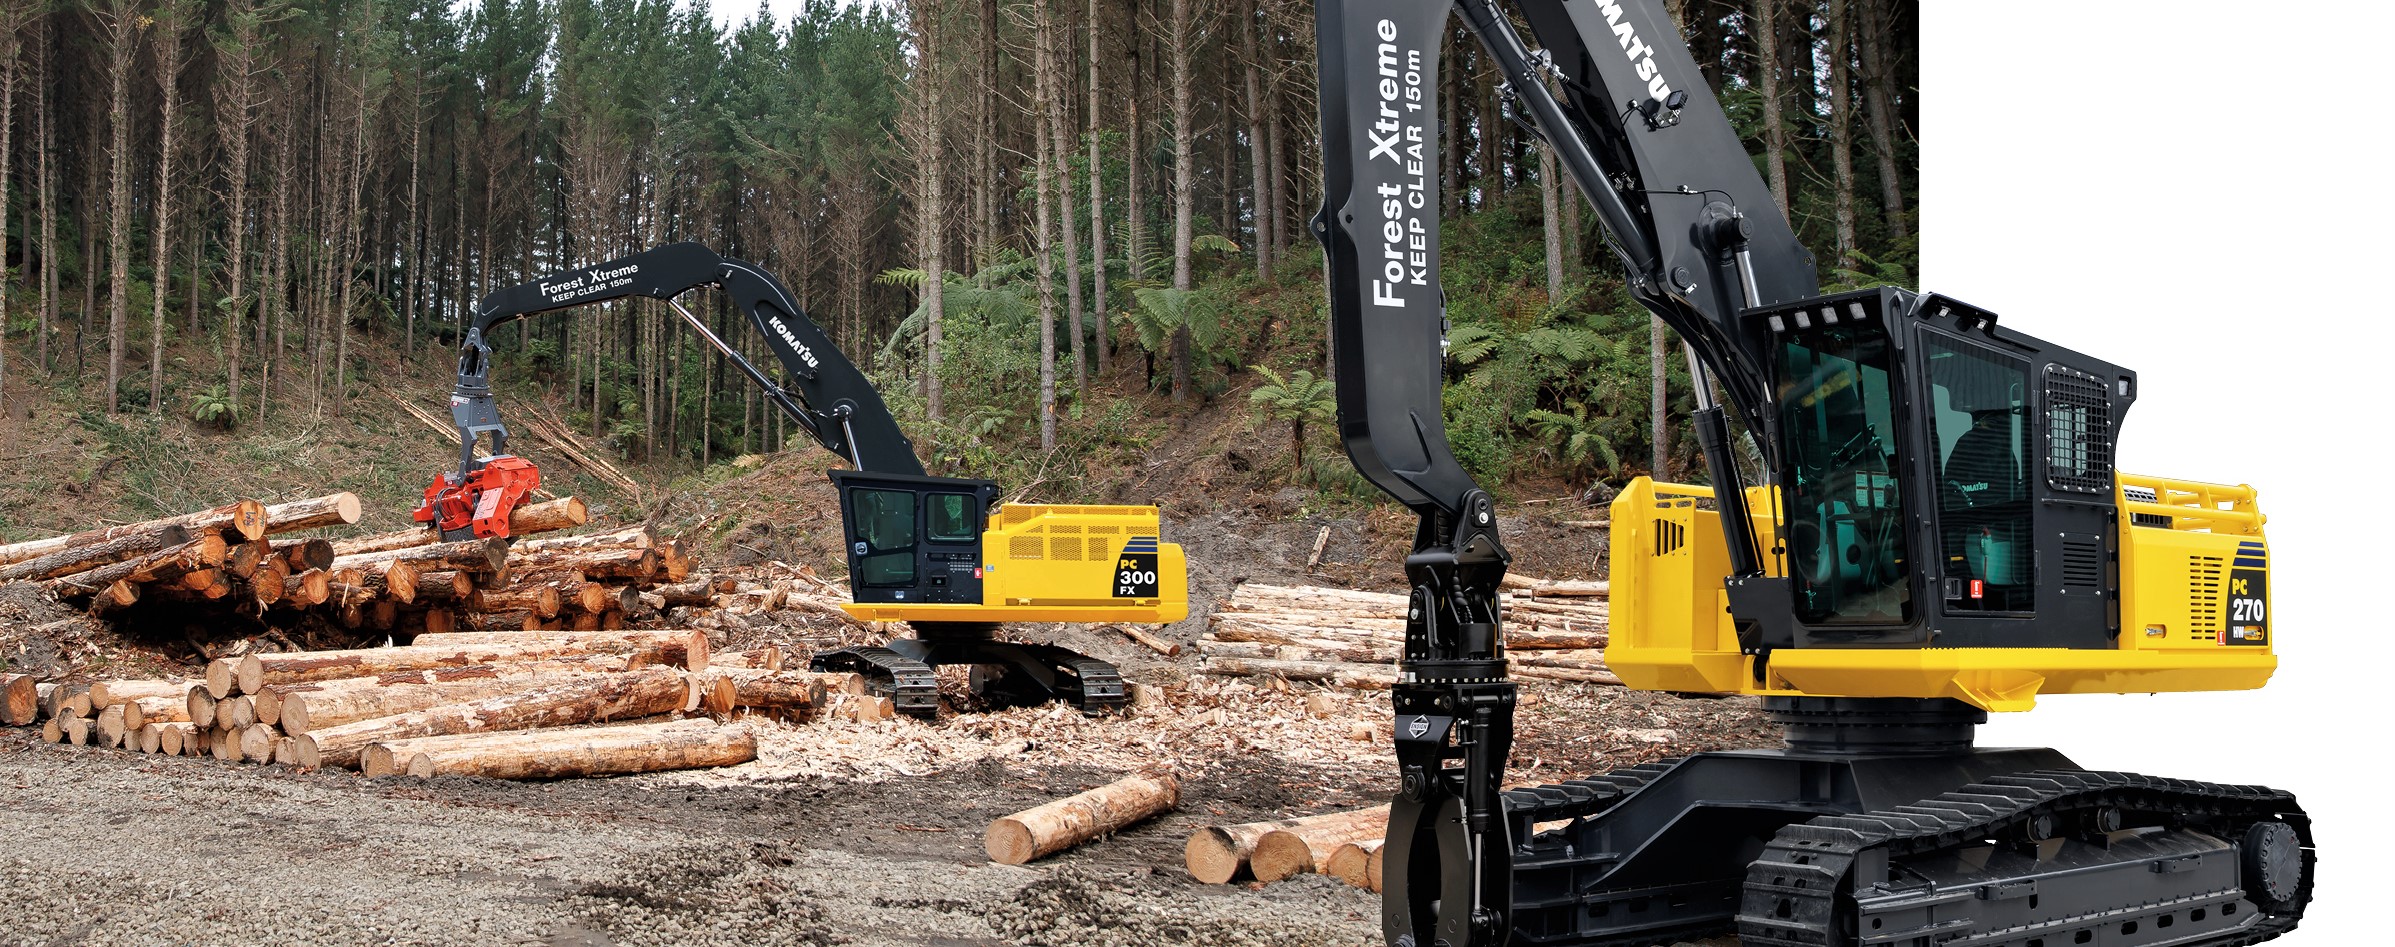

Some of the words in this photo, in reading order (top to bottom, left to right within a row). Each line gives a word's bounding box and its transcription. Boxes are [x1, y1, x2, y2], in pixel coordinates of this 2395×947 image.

[1368, 18, 1401, 165] Xtreme
[1405, 49, 1421, 113] 150m
[1406, 124, 1425, 209] CLEAR
[1373, 182, 1405, 308] Forest
[1410, 217, 1427, 286] KEEP
[540, 276, 584, 297] Forest
[589, 264, 639, 284] Xtreme
[551, 291, 575, 303] KEEP
[577, 283, 607, 296] CLEAR
[609, 277, 633, 288] 150m
[768, 315, 819, 368] KOMATSU
[1962, 481, 1988, 492] OMATSU
[1120, 559, 1137, 569] PC
[1120, 570, 1156, 585] 300
[1120, 586, 1135, 595] FX
[2232, 579, 2247, 595] PC
[2232, 598, 2264, 622] 270
[2233, 626, 2244, 638] HW
